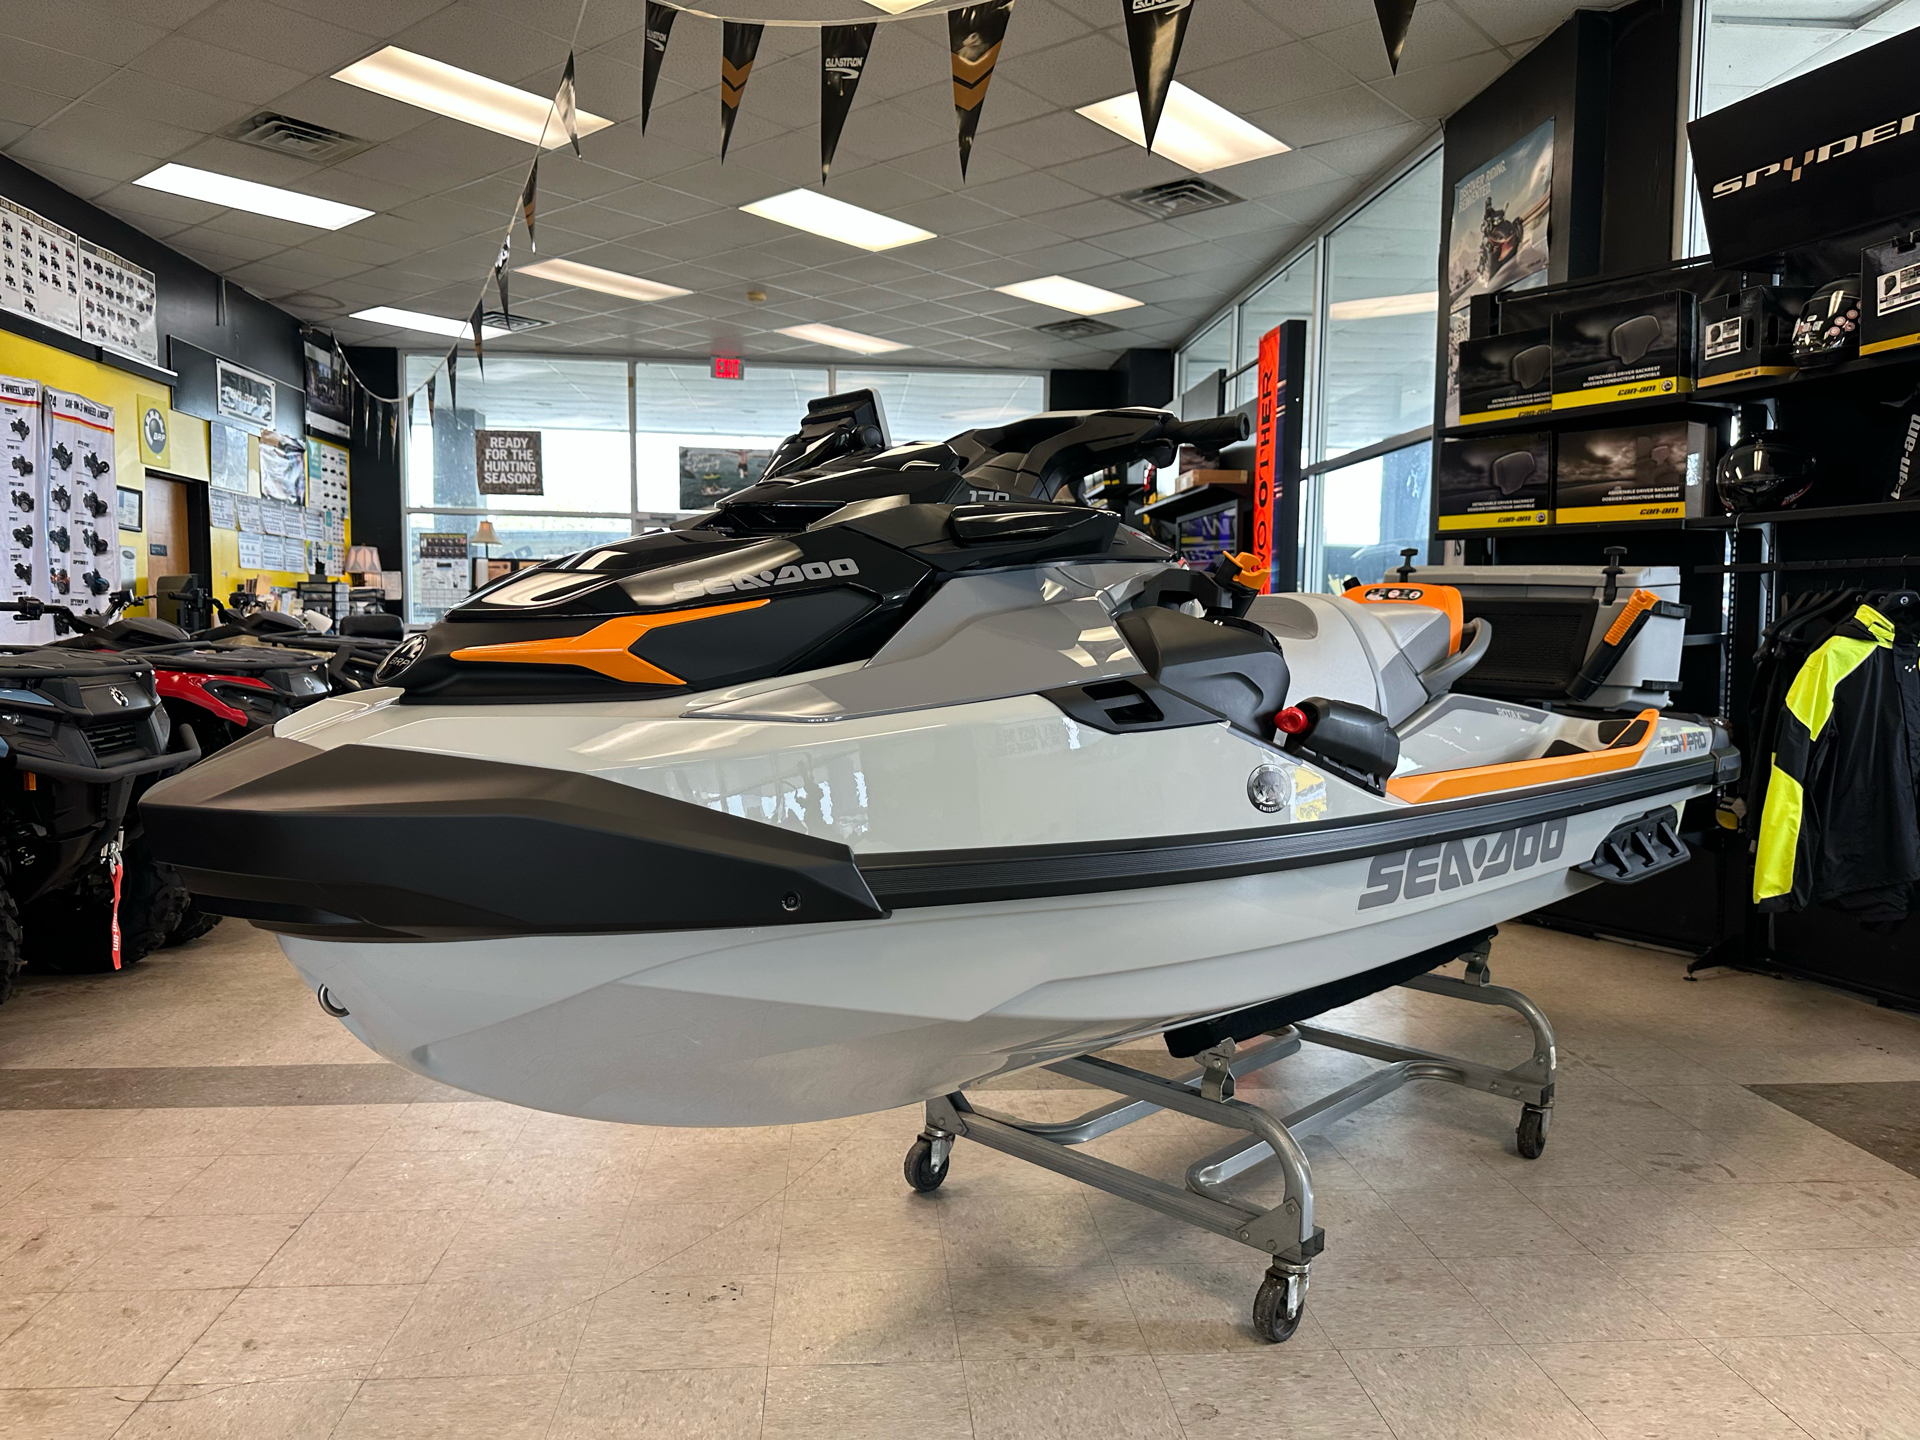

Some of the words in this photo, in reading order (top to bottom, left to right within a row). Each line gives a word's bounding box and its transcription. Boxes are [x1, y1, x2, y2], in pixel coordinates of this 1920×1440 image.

[825, 57, 862, 67] GLASTRON
[715, 358, 740, 379] EXIT
[1588, 372, 1617, 381] DETACHABLE
[1617, 369, 1635, 378] DRIVER
[1635, 365, 1660, 375] BACKREST
[1583, 380, 1603, 388] DOSSIER
[1603, 375, 1635, 384] CONDUCTEUR
[1617, 385, 1657, 396] can-am
[153, 432, 166, 441] BRP
[1260, 371, 1273, 508] OTHER
[490, 437, 529, 449] READY
[485, 449, 508, 460] FOR
[511, 449, 534, 460] THE
[1890, 413, 1920, 500] can-am
[484, 461, 537, 472] HUNTING
[484, 472, 538, 484] SEASON?
[1639, 507, 1679, 515] can-am
[1497, 515, 1531, 523] can-am
[389, 656, 411, 667] BRP
[1259, 801, 1286, 813] EMISSIO
